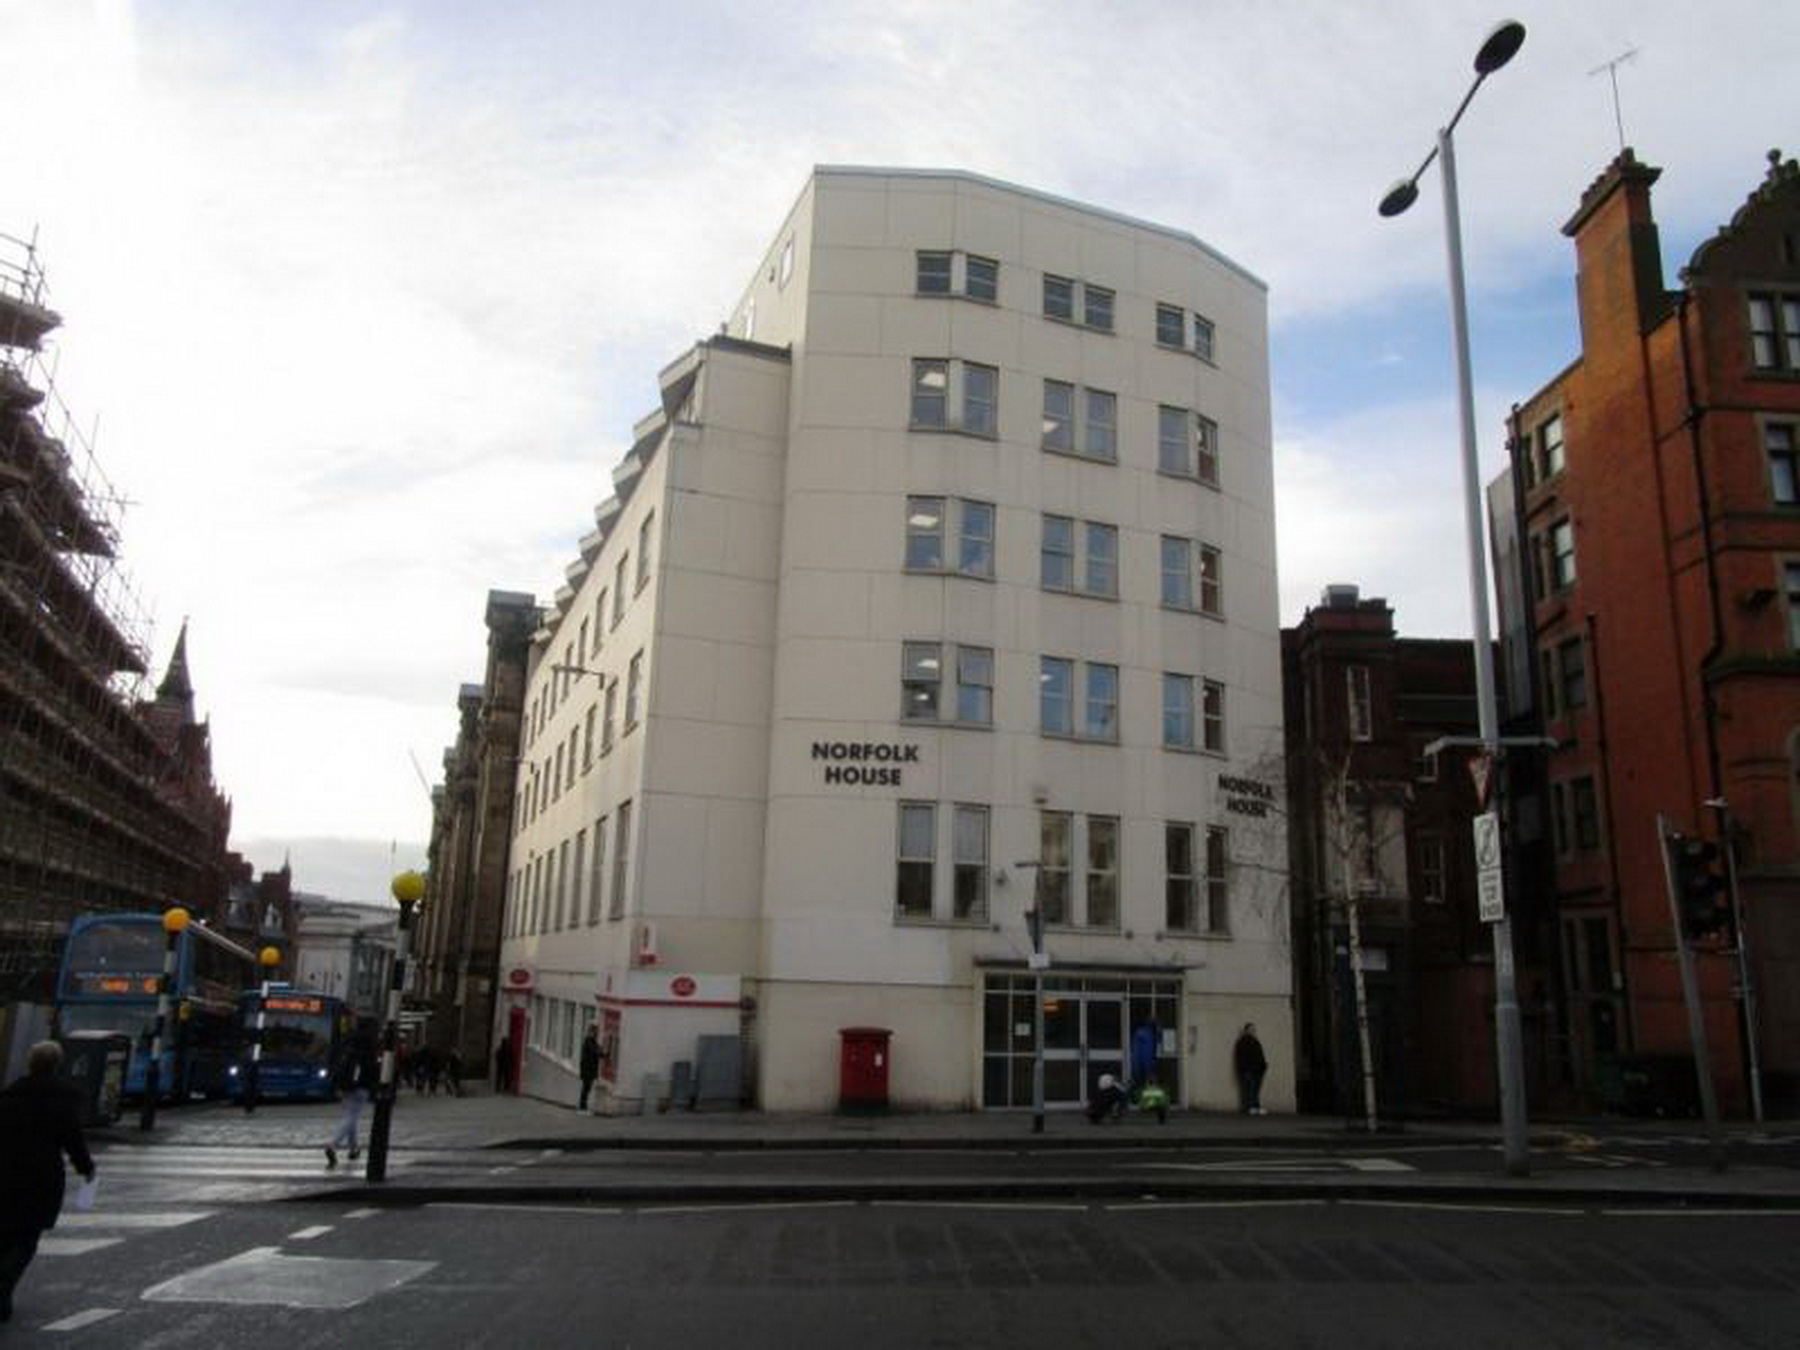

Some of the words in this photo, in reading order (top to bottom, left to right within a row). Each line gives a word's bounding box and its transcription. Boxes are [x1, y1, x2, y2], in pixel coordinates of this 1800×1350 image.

[812, 742, 919, 762] NORFOLK
[825, 766, 902, 786] HOUSE
[1227, 796, 1267, 818] HOUSE
